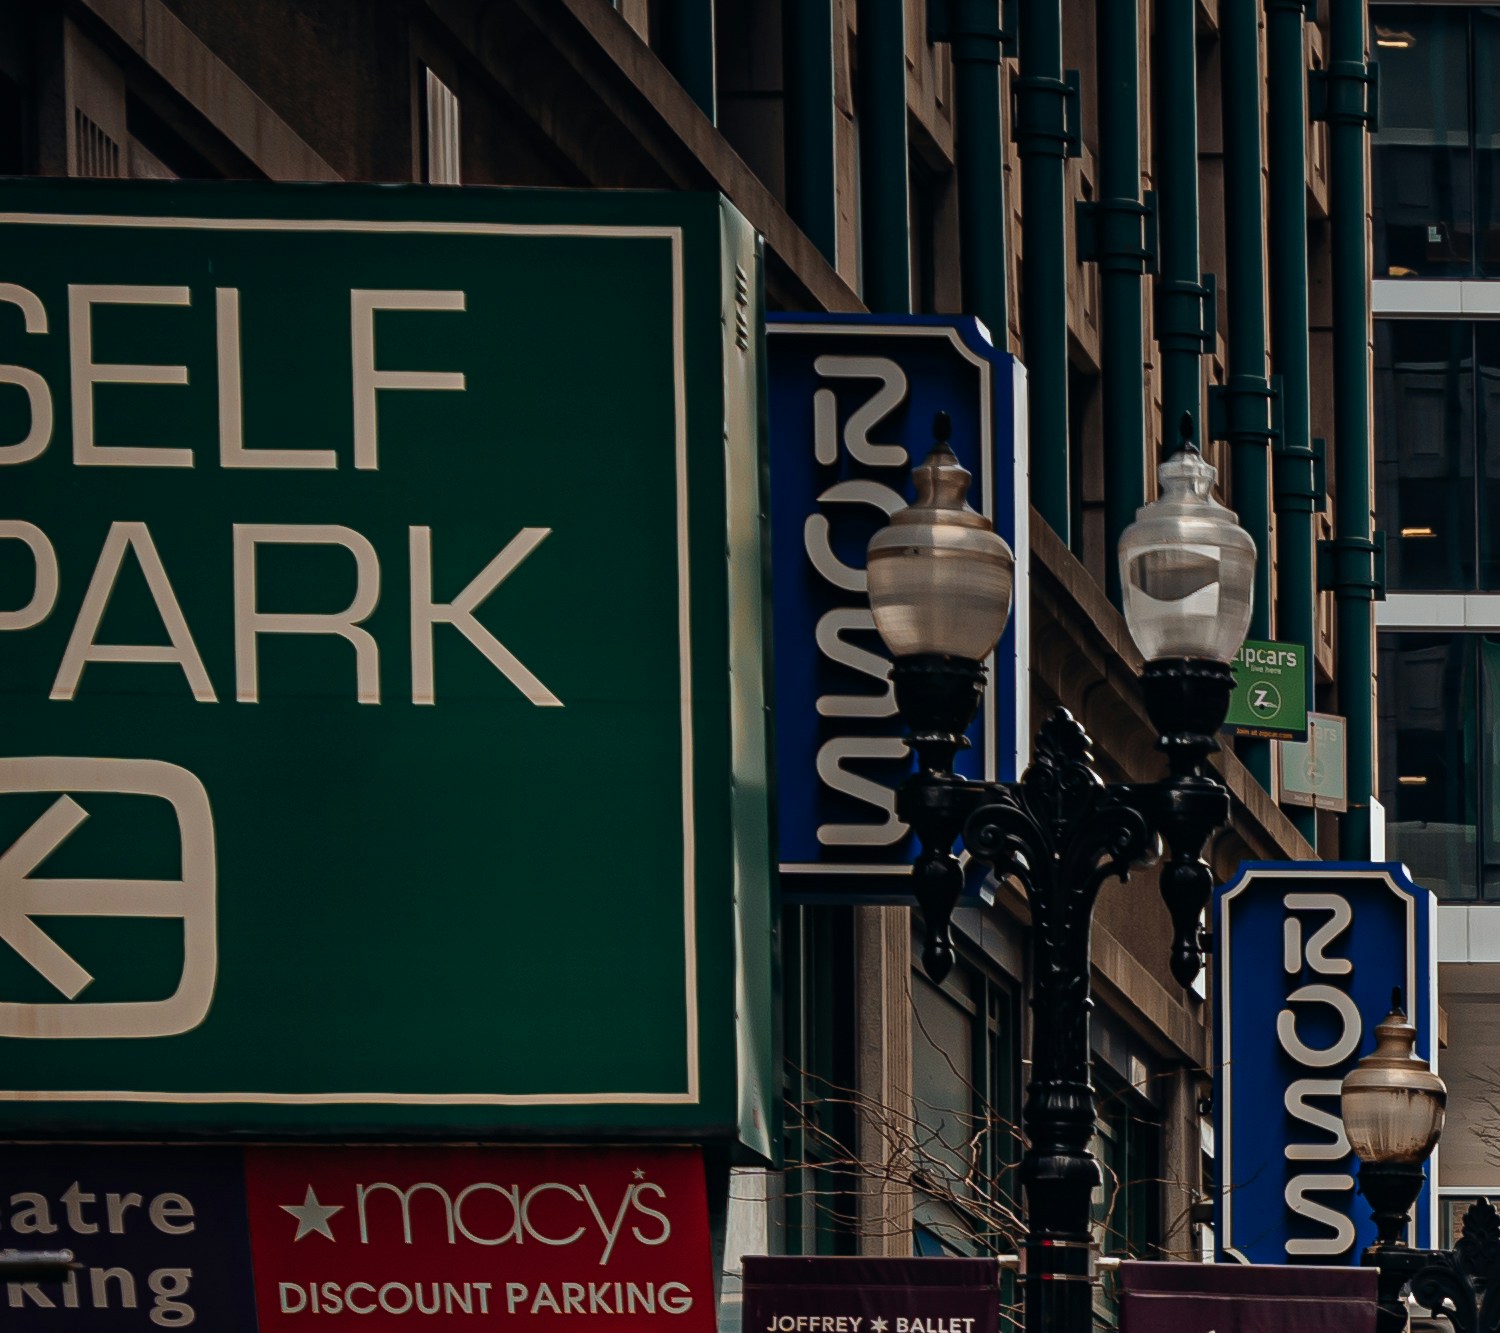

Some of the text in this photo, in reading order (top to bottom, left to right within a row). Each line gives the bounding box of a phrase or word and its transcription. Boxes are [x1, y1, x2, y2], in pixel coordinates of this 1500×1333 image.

[1276, 892, 1362, 1255] ROSS
[0, 1181, 194, 1237] atre
[357, 1168, 671, 1266] macy's
[8, 1264, 194, 1328] king
[279, 1281, 694, 1316] DISCOUNT PARKING
[766, 1315, 975, 1333] JOFFREY BALLET
